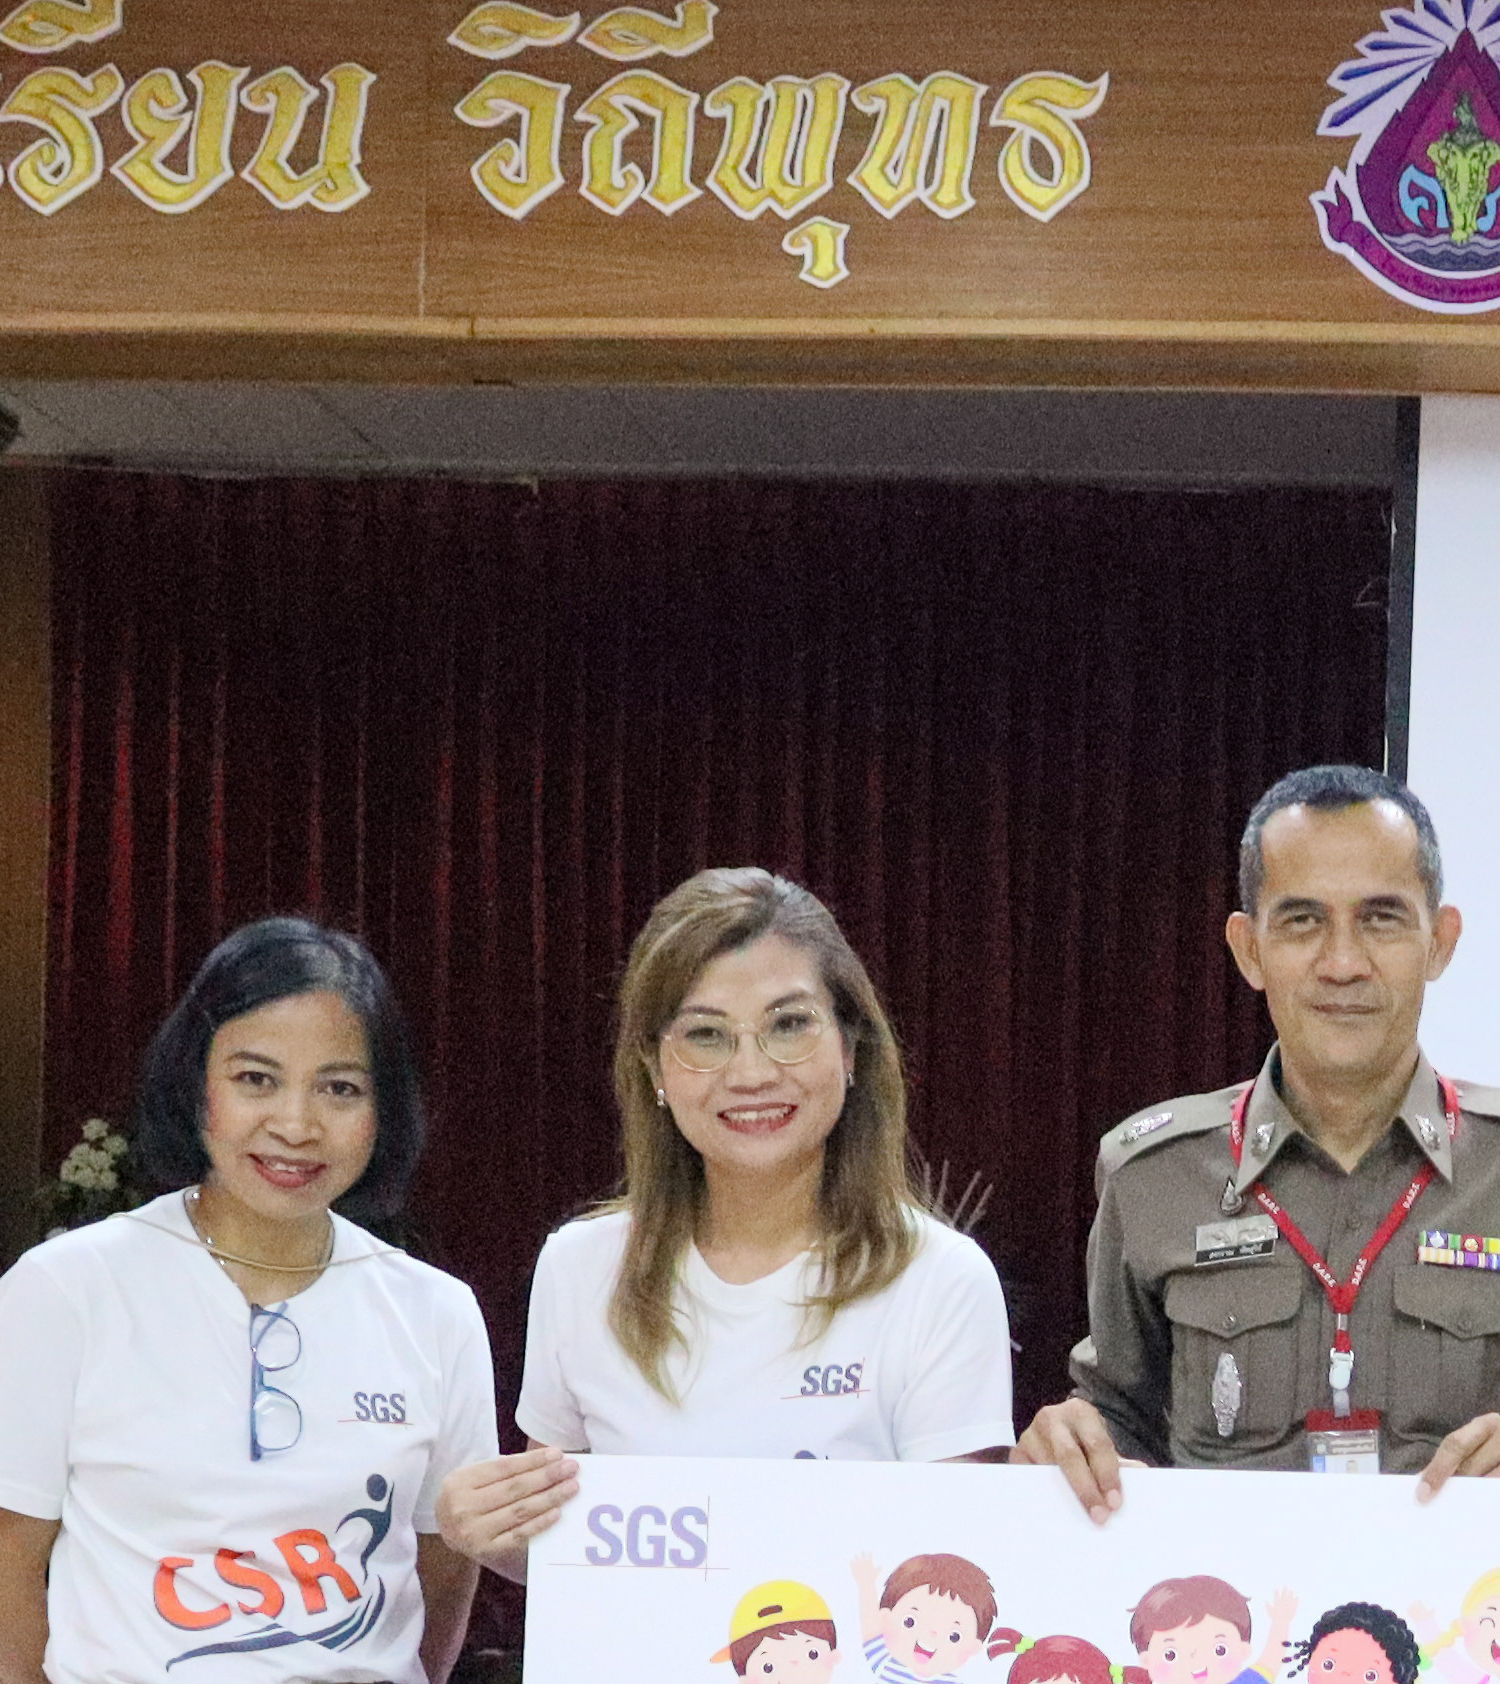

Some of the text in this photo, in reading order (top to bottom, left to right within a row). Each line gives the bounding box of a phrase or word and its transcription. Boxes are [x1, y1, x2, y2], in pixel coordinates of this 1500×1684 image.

[447, 0, 1109, 289] วิถีพุทธ
[354, 1391, 407, 1424] SGS
[800, 1363, 863, 1397] SGS
[585, 1504, 709, 1569] SGS
[153, 1528, 362, 1631] CSR
